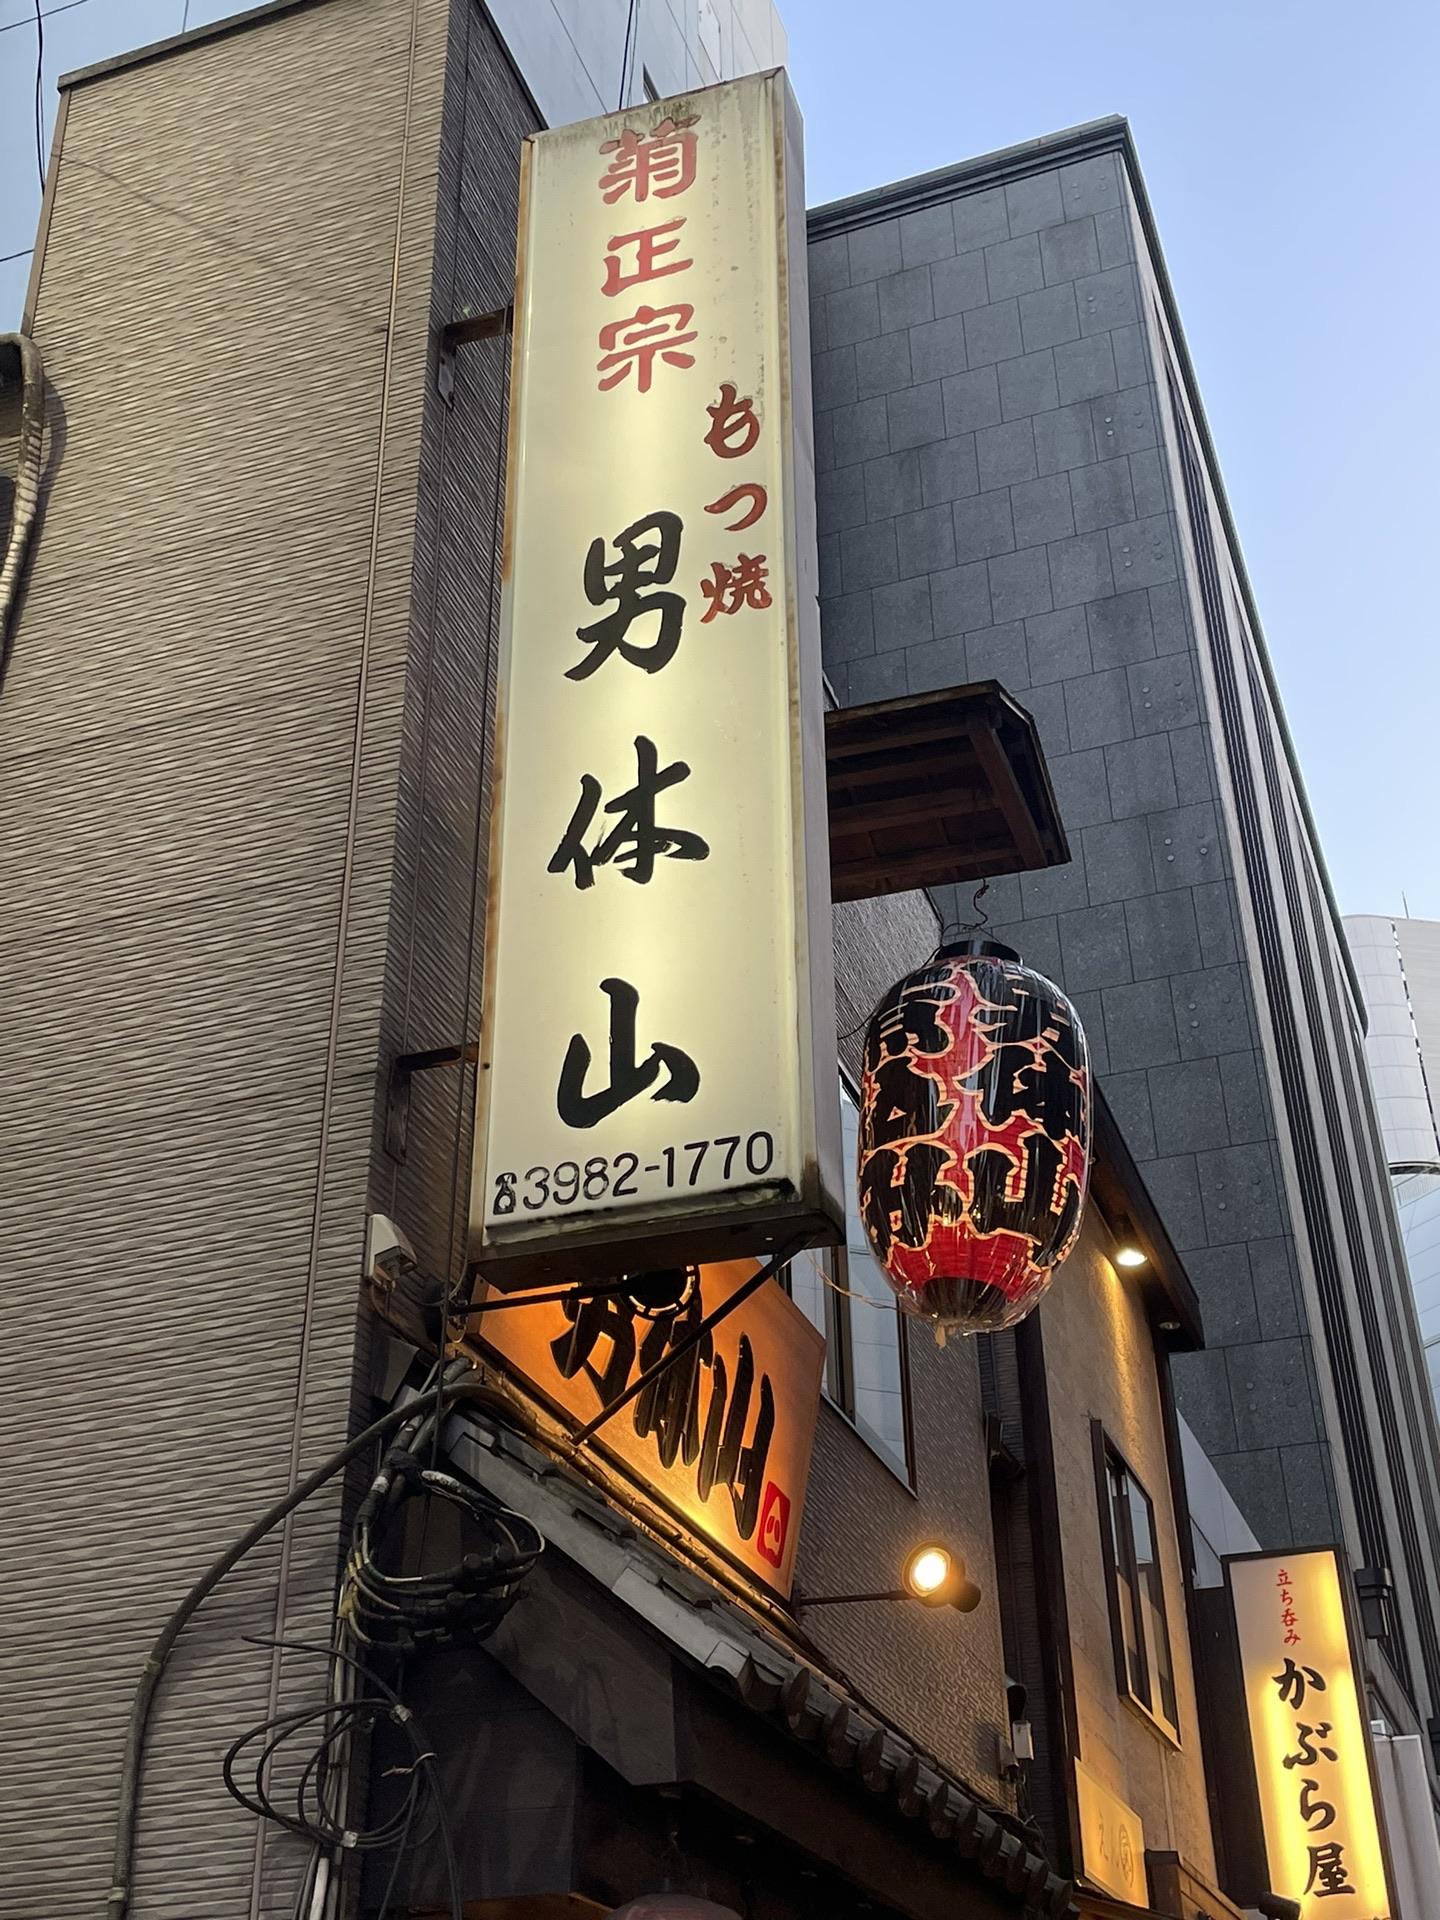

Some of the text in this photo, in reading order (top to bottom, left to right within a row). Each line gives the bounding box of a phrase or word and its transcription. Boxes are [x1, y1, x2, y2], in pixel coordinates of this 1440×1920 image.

[598, 115, 701, 394] 菊正宗
[701, 385, 773, 624] もつ焼
[548, 511, 710, 1129] 男体山
[523, 1130, 775, 1211] 3982-1770
[1276, 1568, 1301, 1646] 立ち呑み
[1272, 1658, 1356, 1898] かぶら屋
